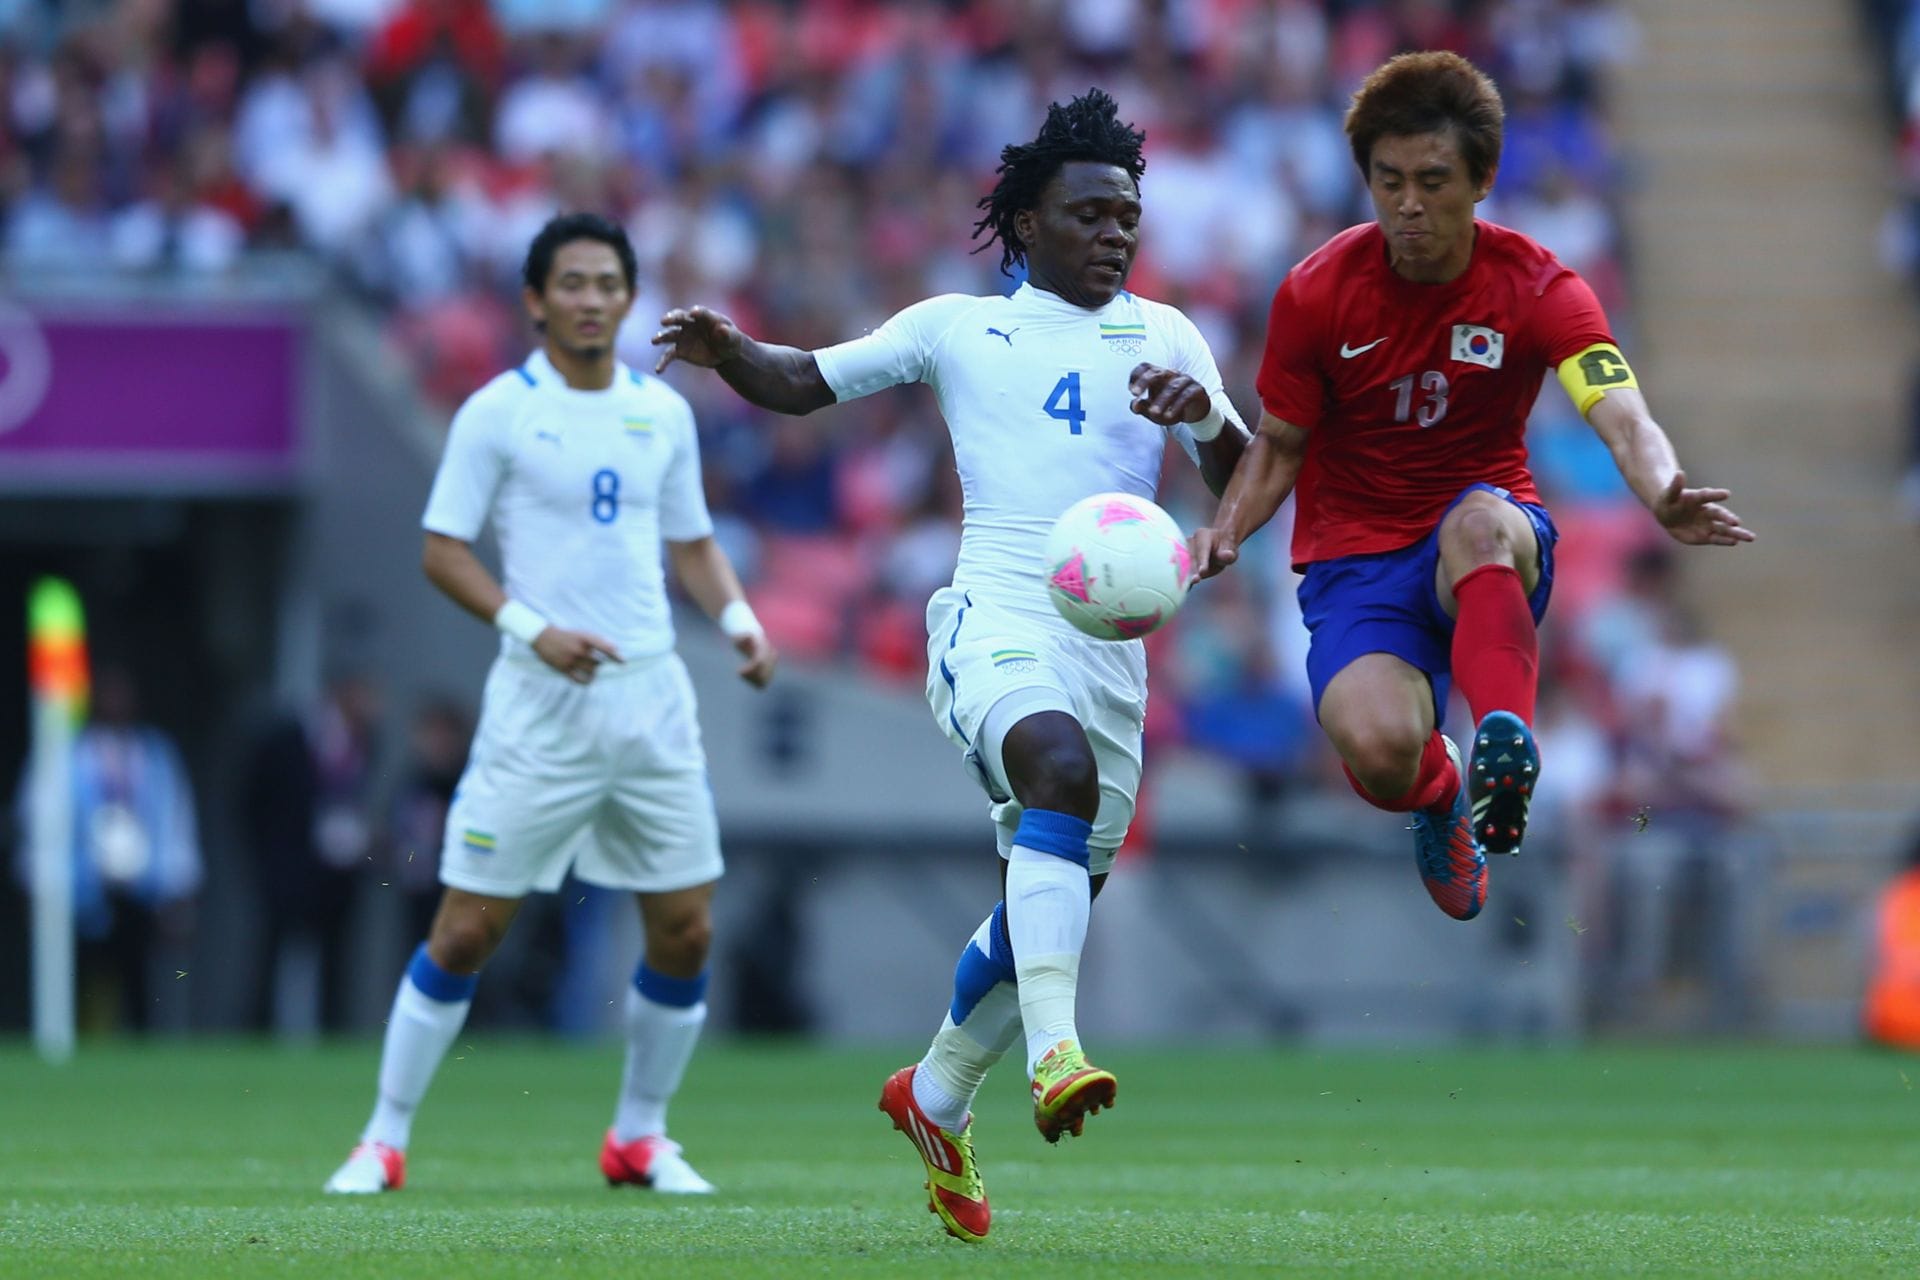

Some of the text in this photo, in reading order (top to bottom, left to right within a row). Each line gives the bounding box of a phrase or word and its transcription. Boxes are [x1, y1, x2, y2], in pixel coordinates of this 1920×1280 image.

[1577, 349, 1630, 386] C
[1043, 372, 1086, 435] 4
[1388, 370, 1450, 428] 13
[592, 469, 620, 524] 8
